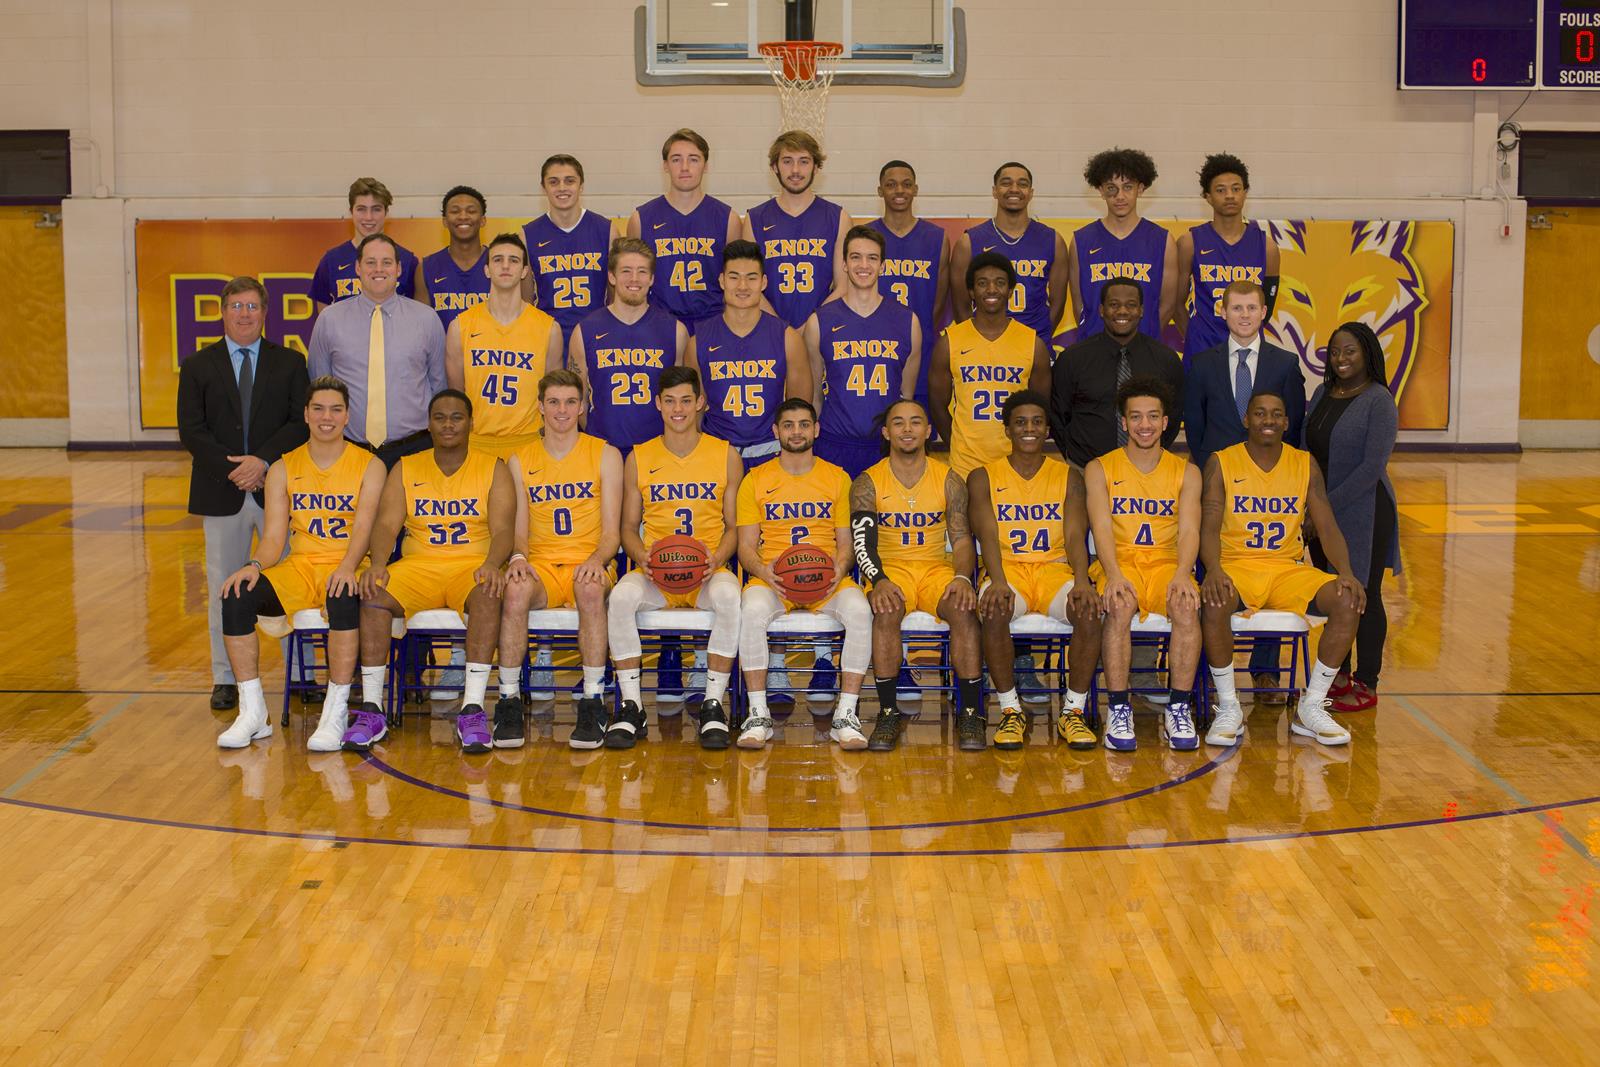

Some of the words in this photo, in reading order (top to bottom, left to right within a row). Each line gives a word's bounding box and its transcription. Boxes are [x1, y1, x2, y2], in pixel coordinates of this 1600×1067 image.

[1560, 13, 1600, 27] FOULS
[1576, 31, 1594, 62] 0
[1473, 58, 1486, 81] 0
[1560, 70, 1600, 84] SCORE
[655, 237, 716, 257] KNOX
[764, 239, 827, 259] KNOX
[538, 252, 602, 275] KNOX
[879, 259, 931, 279] NOX
[1010, 259, 1048, 278] OX
[1090, 262, 1152, 282] KNOX
[670, 260, 707, 292] 42
[778, 262, 814, 294] 33
[1199, 264, 1262, 285] KNOX
[553, 276, 591, 308] 25
[471, 349, 535, 371] KNOX
[596, 348, 664, 369] KNOX
[832, 340, 899, 360] KNOX
[709, 359, 777, 381] KNOX
[846, 364, 889, 396] 44
[959, 365, 1025, 384] KNOX
[481, 374, 520, 407] 45
[611, 372, 651, 405] 23
[723, 384, 765, 417] 45
[292, 493, 355, 512] KNOX
[528, 481, 594, 504] KNOX
[649, 482, 717, 502] KNOX
[414, 498, 480, 517] KNOX
[765, 502, 833, 521] KNOX
[997, 503, 1062, 522] KNOX
[1111, 497, 1175, 516] KNOX
[1233, 495, 1299, 515] KNOX
[308, 517, 349, 539] 42
[553, 507, 573, 536] 0
[674, 507, 694, 537] 3
[877, 511, 945, 529] KNOX
[427, 521, 470, 545] 52
[790, 525, 812, 546] 2
[1008, 528, 1051, 555] 24
[1134, 523, 1154, 546] 4
[1245, 521, 1286, 550] 32
[659, 552, 699, 564] Wilson
[787, 554, 827, 566] Wilson
[664, 571, 694, 582] NCAA
[793, 573, 823, 584] NCAA
